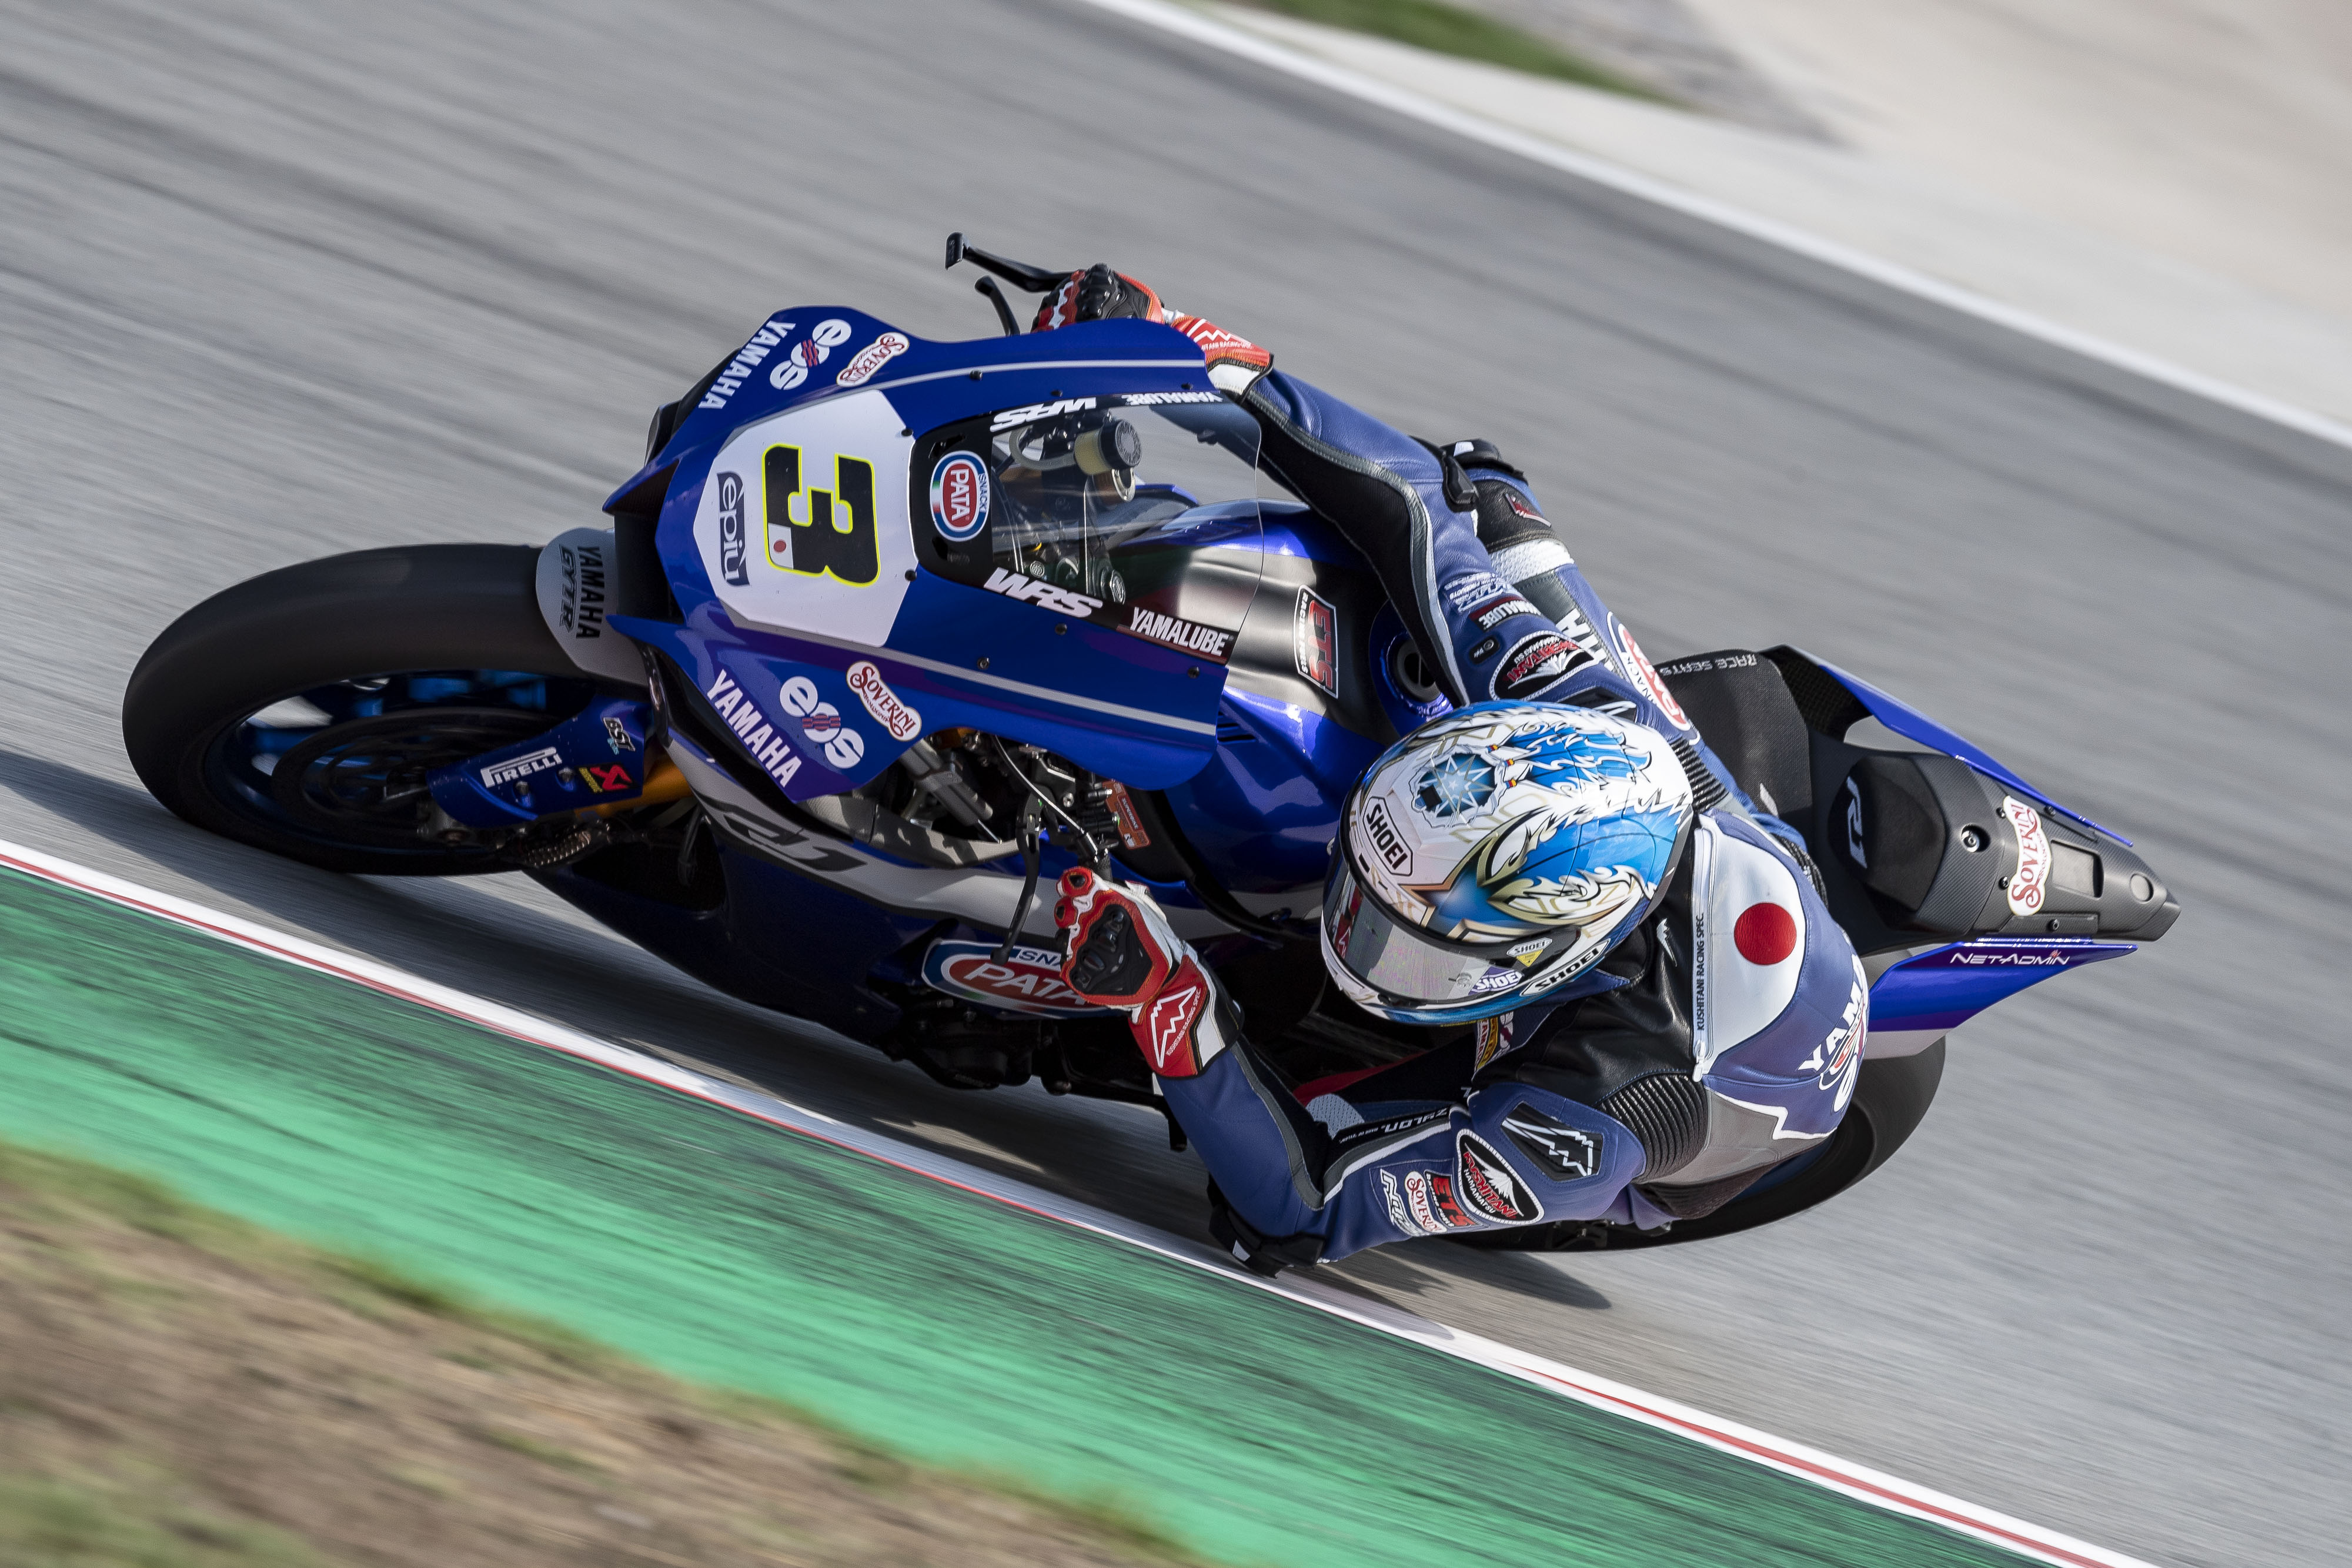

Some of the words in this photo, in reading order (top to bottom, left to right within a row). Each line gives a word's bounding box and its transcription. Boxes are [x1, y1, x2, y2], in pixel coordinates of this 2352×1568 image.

[699, 320, 796, 409] YAMAHA
[990, 397, 1096, 432] WRS
[1121, 392, 1223, 405] YAMALUBE
[762, 443, 881, 587] 3
[950, 469, 970, 521] PATA
[559, 544, 577, 633] GYTR
[576, 546, 604, 638] YAMAHA
[984, 567, 1103, 617] WRS
[1130, 607, 1229, 656] YAMALUBE
[1308, 600, 1333, 689] ETS
[1659, 660, 1712, 676] SEATS
[1715, 654, 1757, 669] RACE
[849, 666, 917, 738] SOVERINI
[603, 717, 635, 752] BST
[707, 669, 802, 788] YAMAHA
[481, 747, 562, 788] PIRELLI
[1366, 804, 1408, 870] SHOEI
[2011, 801, 2043, 909] SOVERINI
[1696, 913, 1705, 944] SPEC.
[1475, 971, 1520, 992] SHOEI
[1532, 948, 1601, 996] SHOEI
[1696, 945, 1705, 977] RACING
[1183, 1006, 1195, 1030] RACING
[1696, 978, 1705, 1031] KUSHITANI
[1434, 1178, 1476, 1227] ETS
[1464, 1151, 1518, 1218] KUSHITANI
[1464, 1169, 1495, 1213] HAMAMATSU
